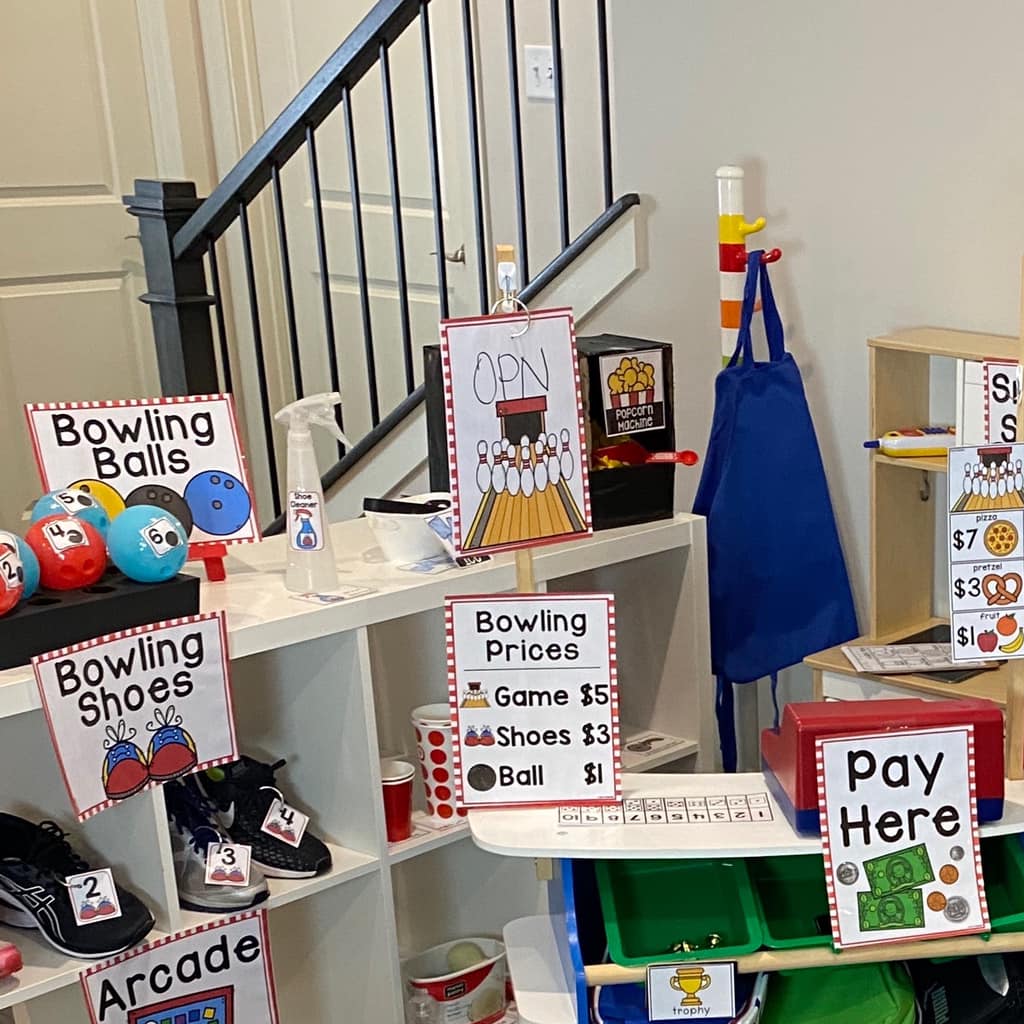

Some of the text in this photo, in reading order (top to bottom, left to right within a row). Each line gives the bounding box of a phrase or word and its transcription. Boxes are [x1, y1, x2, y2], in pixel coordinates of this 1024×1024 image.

[473, 348, 549, 404] OPN
[52, 409, 215, 447] Bowling
[93, 444, 191, 480] Balls
[59, 492, 74, 504] 5
[976, 514, 997, 523] pizza
[49, 524, 65, 538] 4
[150, 528, 163, 544] 6
[953, 528, 978, 551] $7
[3, 561, 17, 580] 2
[973, 563, 1003, 573] pretzel
[954, 577, 981, 599] $3
[476, 610, 587, 637] Bowling
[980, 612, 1000, 620] fruit
[957, 625, 975, 647] $1
[486, 639, 580, 662] Prices
[55, 632, 204, 696] Bowling
[78, 670, 194, 727] Shoes
[494, 683, 609, 707] Game $5
[496, 722, 611, 747] Shoes $3
[499, 762, 603, 787] Ball $1
[847, 749, 944, 797] Pay
[280, 807, 294, 825] 4
[839, 804, 961, 847] Here
[221, 847, 235, 865] 3
[84, 876, 101, 899] 2
[100, 934, 260, 1022] Arcade
[673, 1006, 711, 1017] trophy
